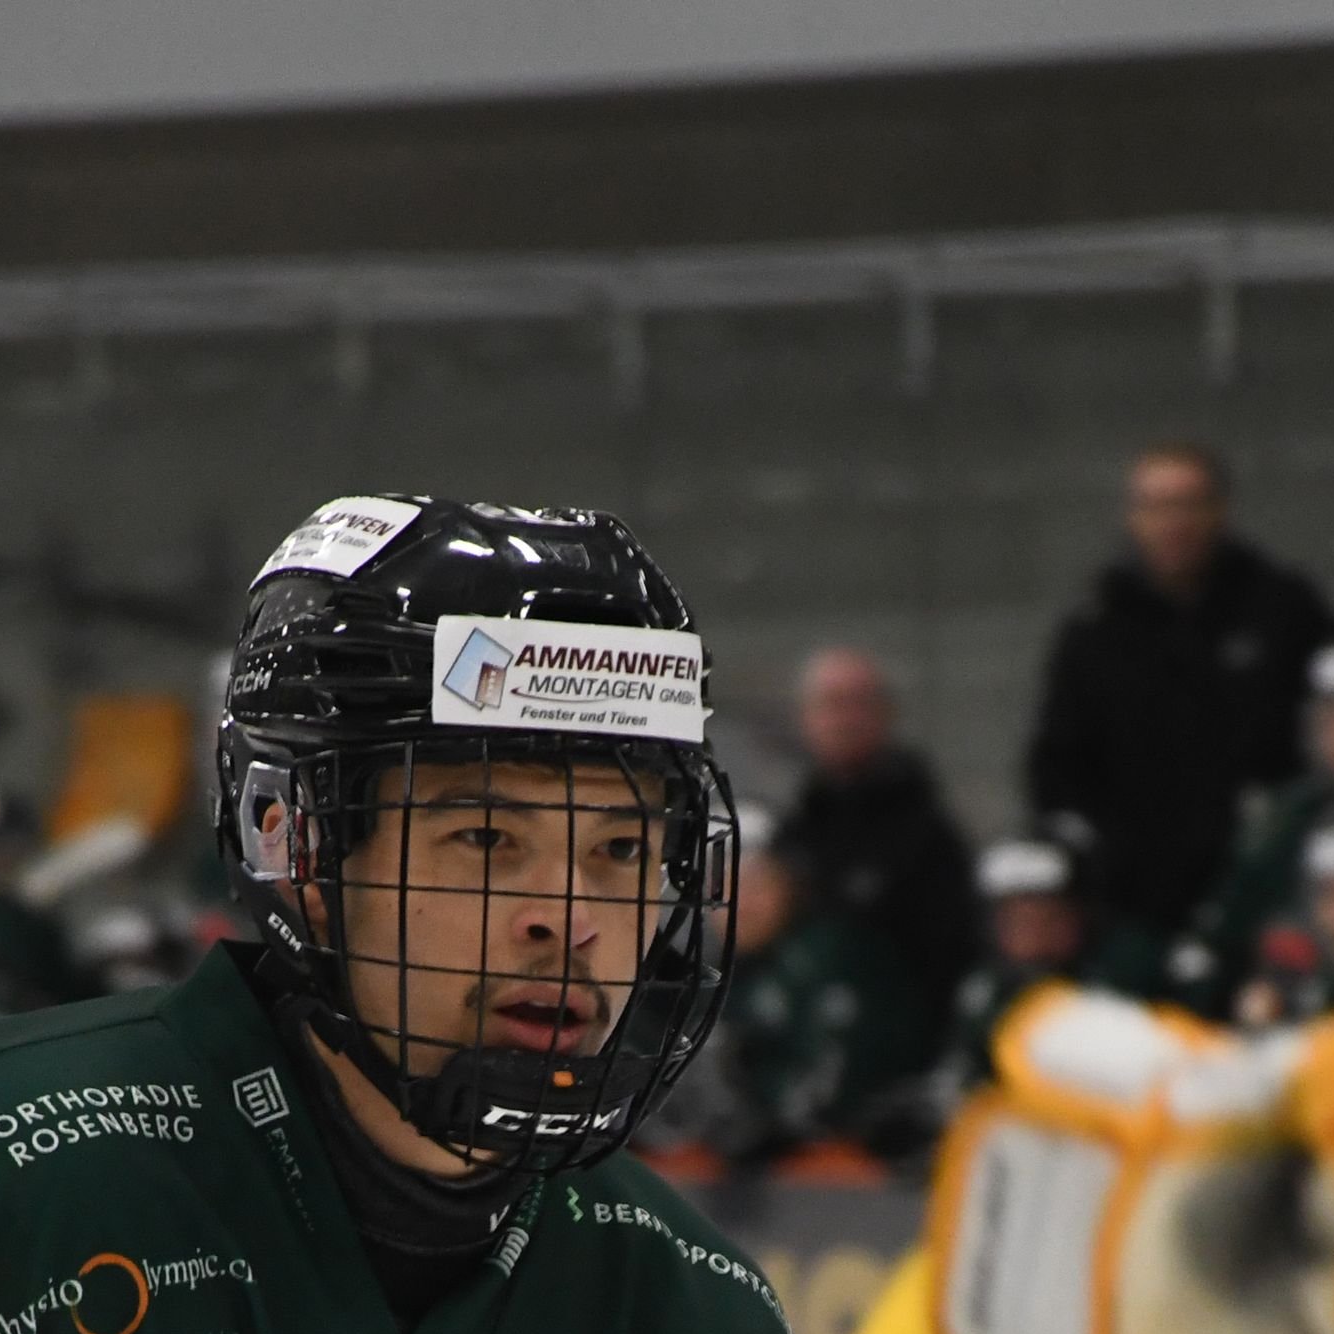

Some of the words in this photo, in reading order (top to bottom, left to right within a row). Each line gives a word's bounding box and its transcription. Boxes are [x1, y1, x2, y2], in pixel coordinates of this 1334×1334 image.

[514, 643, 699, 682] AMMANNFEN
[527, 674, 655, 701] MONTAGEN
[520, 706, 575, 721] Fenster
[579, 709, 605, 723] und
[609, 711, 648, 727] Türen
[8, 1112, 194, 1168] ROSENBERG
